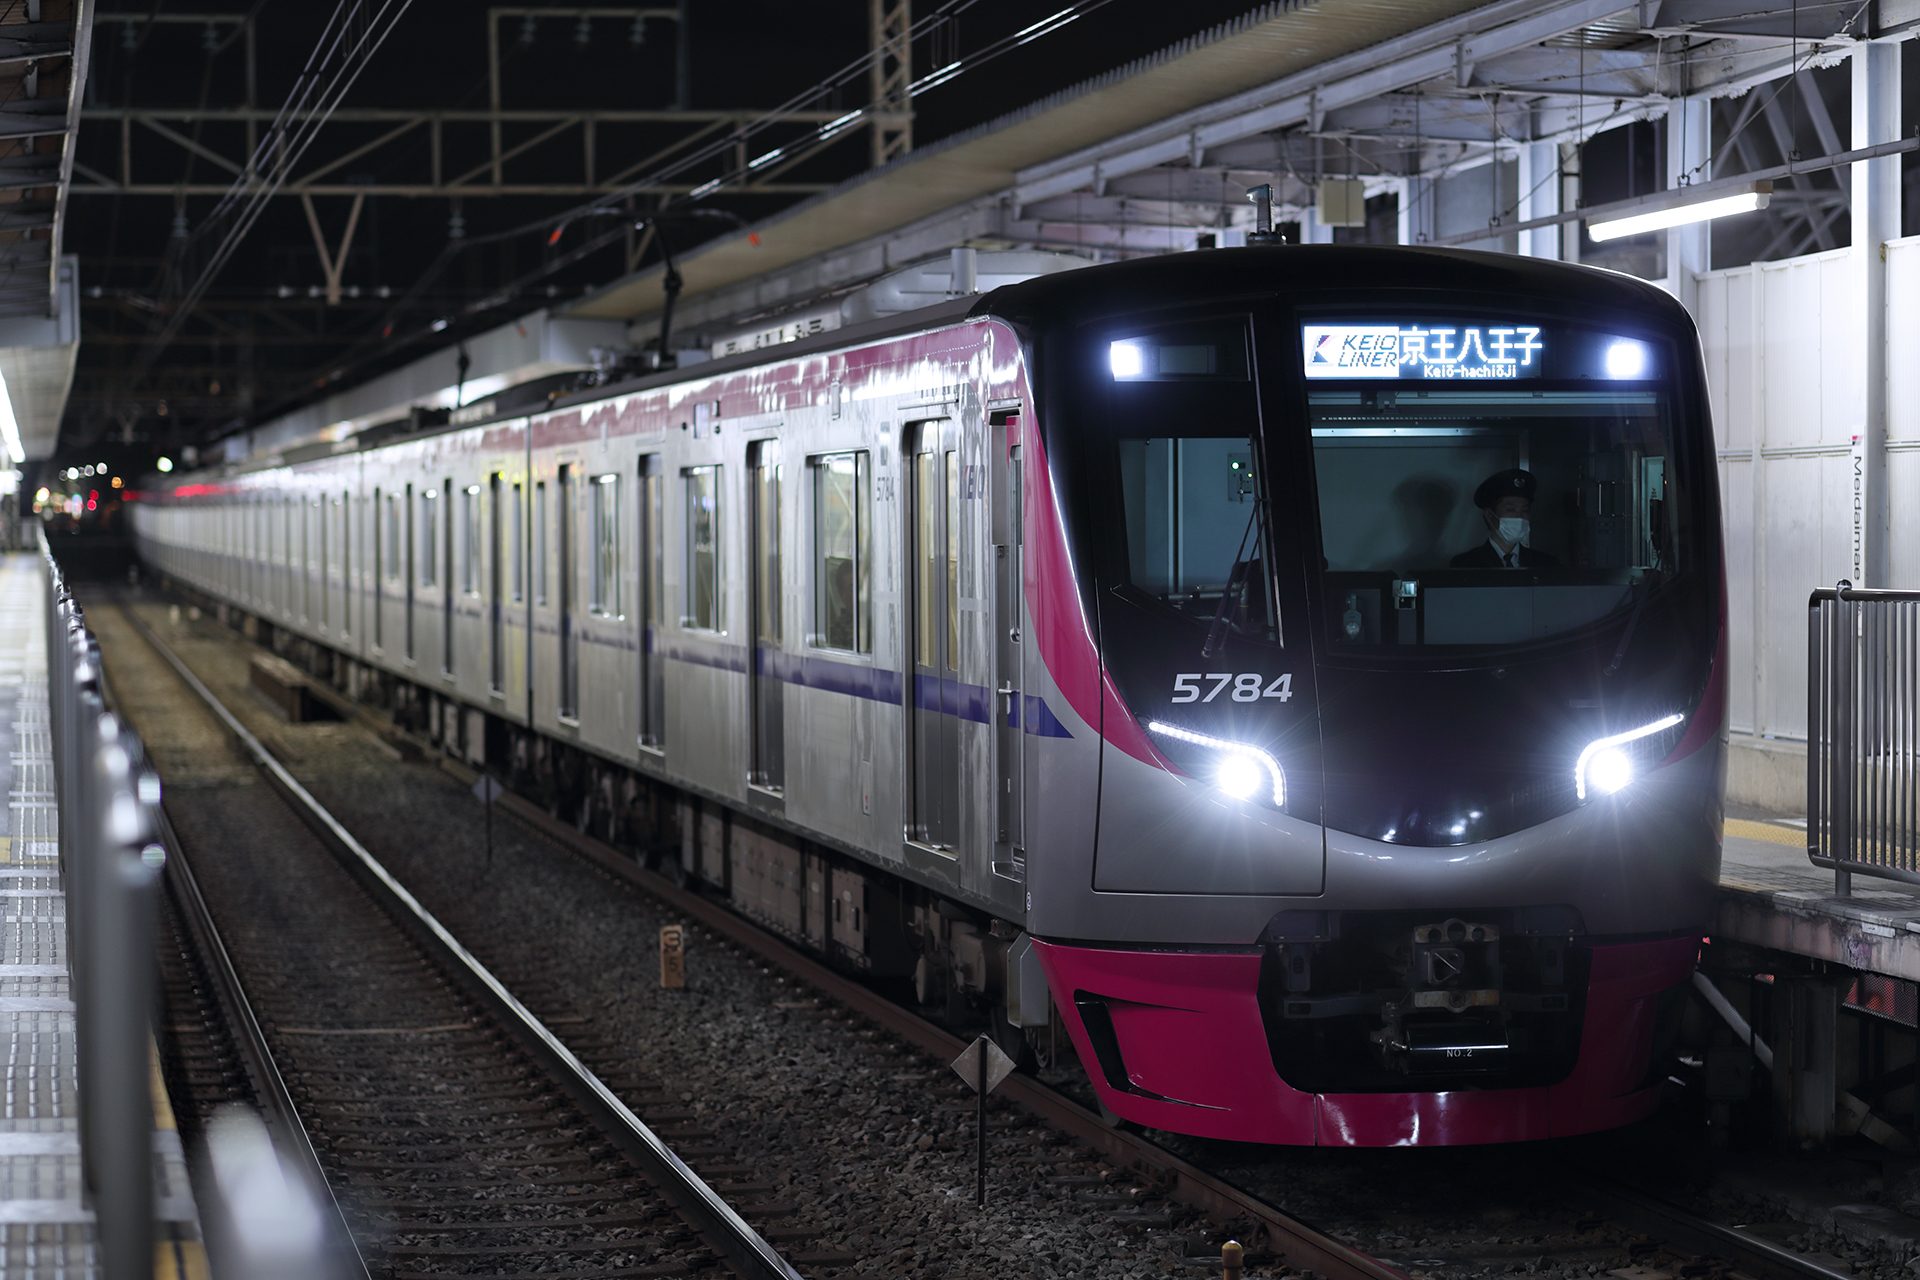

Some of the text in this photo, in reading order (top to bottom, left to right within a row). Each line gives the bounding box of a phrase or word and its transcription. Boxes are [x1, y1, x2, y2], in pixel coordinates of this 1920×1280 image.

[1342, 335, 1397, 350] KEIO
[1399, 326, 1543, 365] 京王八王子
[1338, 352, 1397, 367] LINER
[877, 477, 895, 501] 5784
[960, 464, 985, 500] KEIO
[1854, 456, 1862, 581] Meidaimae
[1171, 673, 1293, 703] 5784
[1446, 1049, 1473, 1058] NO.2
